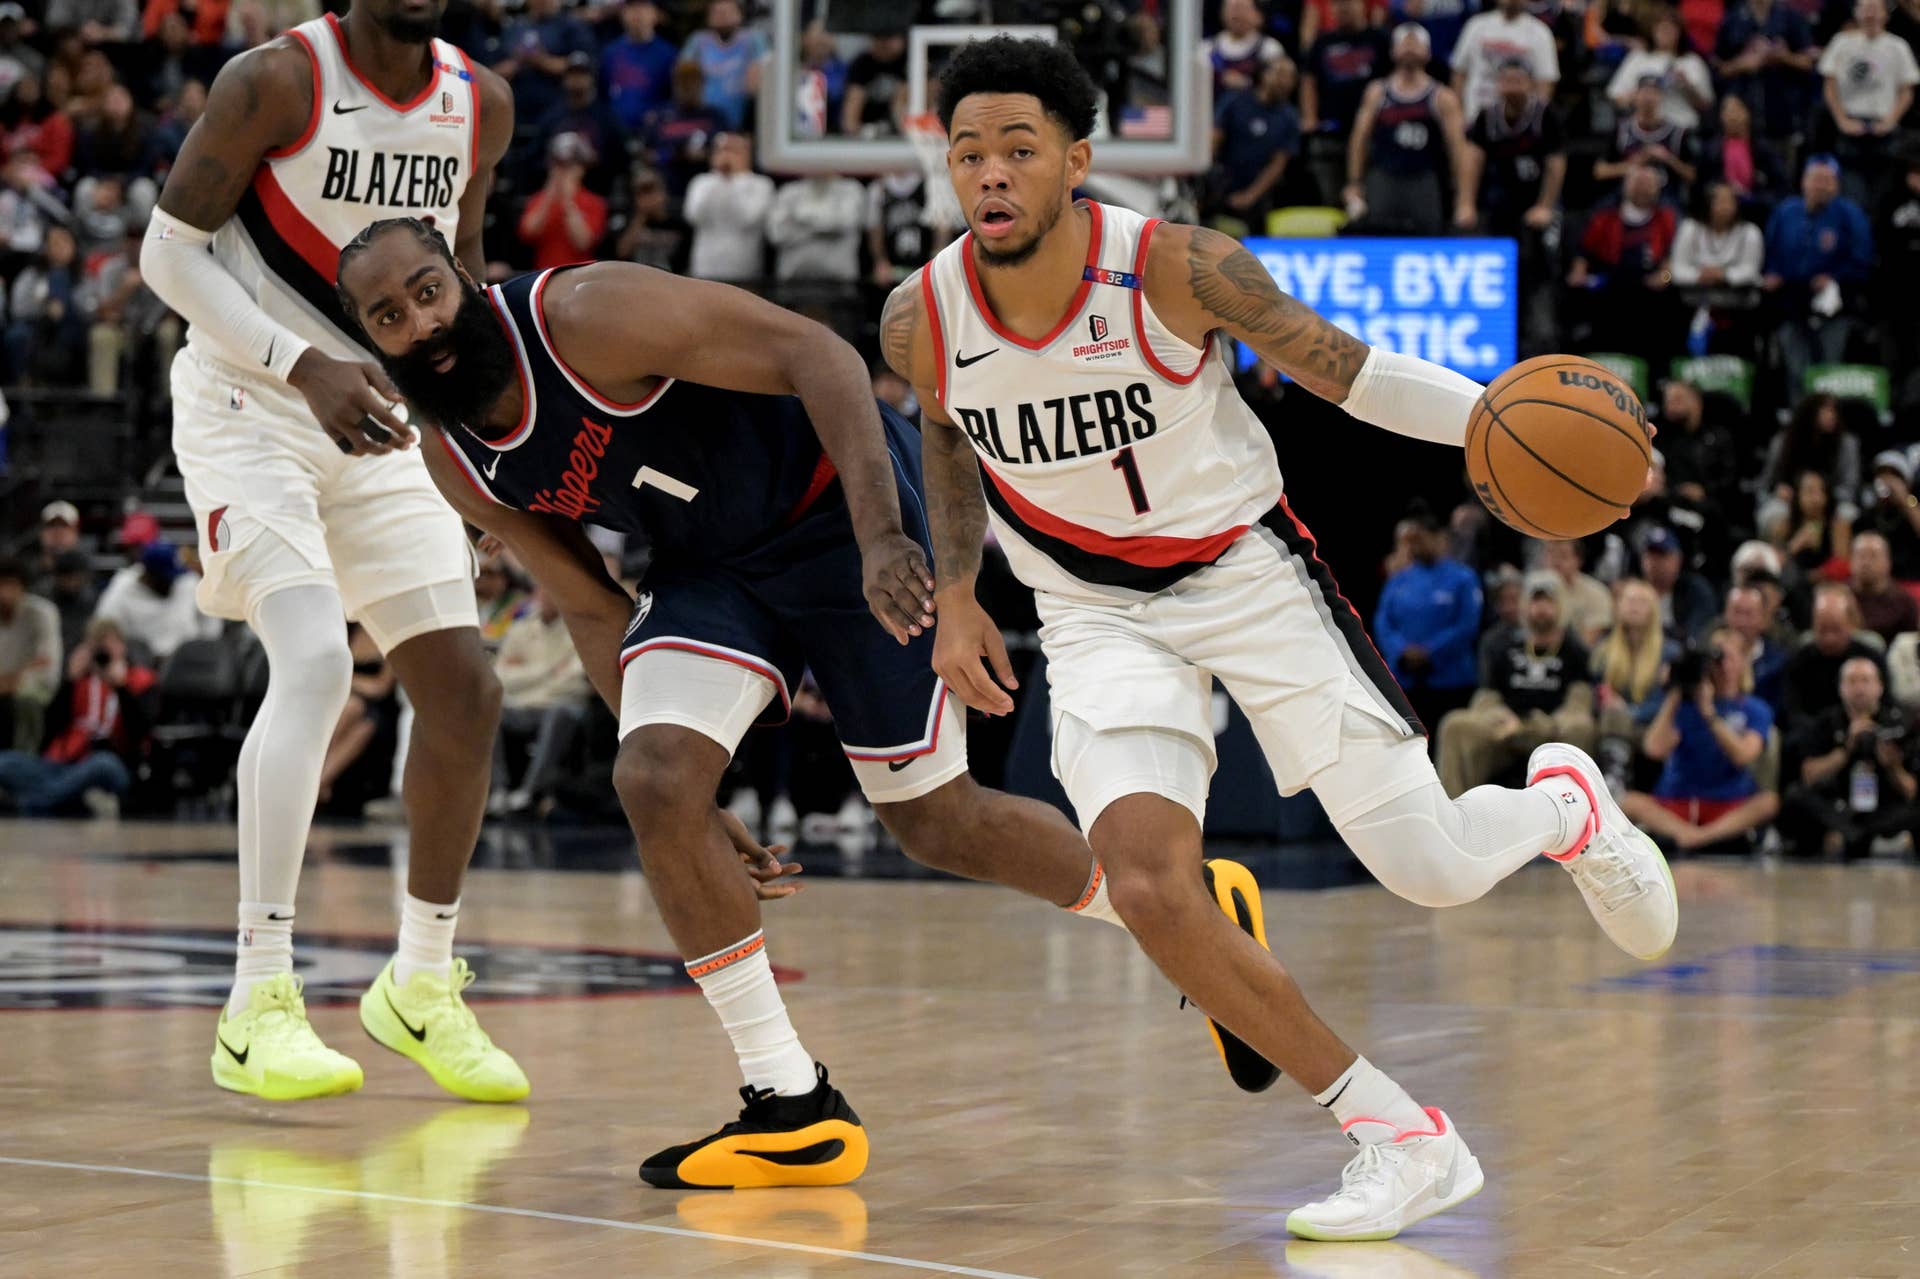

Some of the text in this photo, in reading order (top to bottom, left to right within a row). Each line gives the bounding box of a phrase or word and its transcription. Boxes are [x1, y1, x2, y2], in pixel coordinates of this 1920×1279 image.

[321, 146, 459, 208] BLAZERS
[1107, 272, 1123, 285] 32
[1391, 252, 1506, 309] BYE
[1073, 339, 1130, 357] BRIGHTSIDE
[1085, 352, 1122, 361] WINDOWS
[954, 382, 1157, 464] BLAZERS
[631, 465, 700, 503] 1
[1110, 446, 1152, 516] 1
